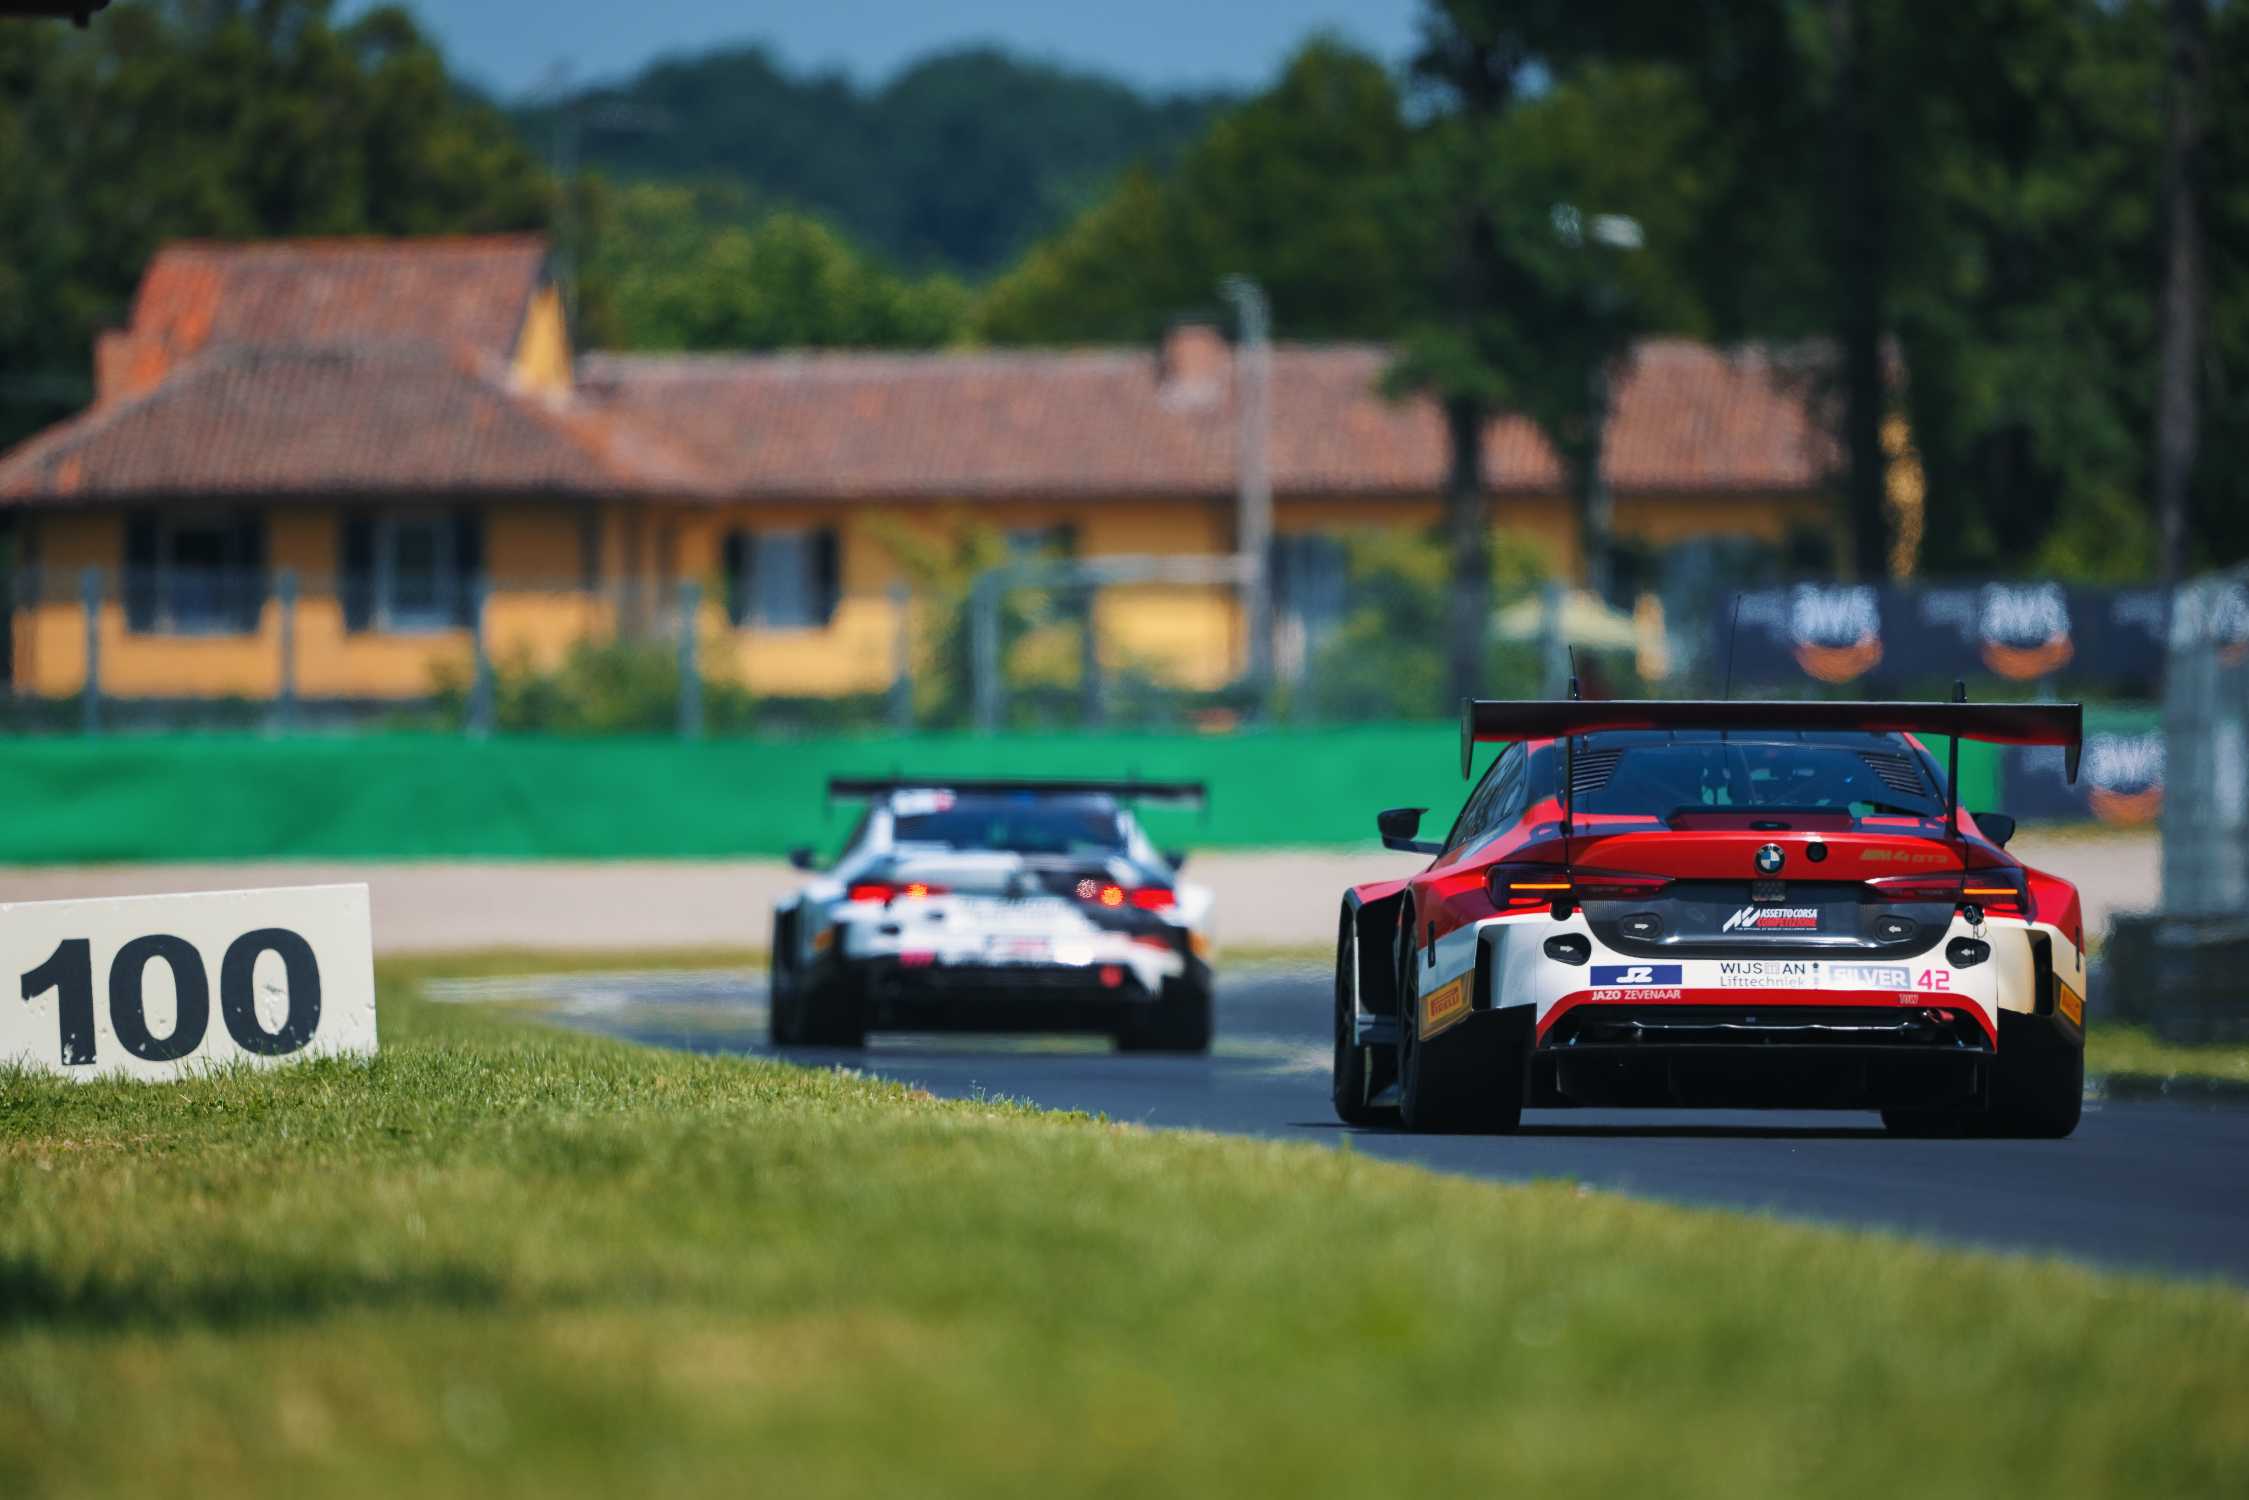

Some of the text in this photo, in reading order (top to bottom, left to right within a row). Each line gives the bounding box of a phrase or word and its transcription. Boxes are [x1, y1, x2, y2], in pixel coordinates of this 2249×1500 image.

[1760, 908, 1818, 918] ASSETTO CORSA
[1720, 976, 1805, 987] Lifttechniek
[1832, 967, 1909, 988] SILVER
[1917, 969, 1950, 991] 42
[20, 927, 322, 1066] 100
[1592, 990, 1681, 1001] JAZO ZEVENAAR
